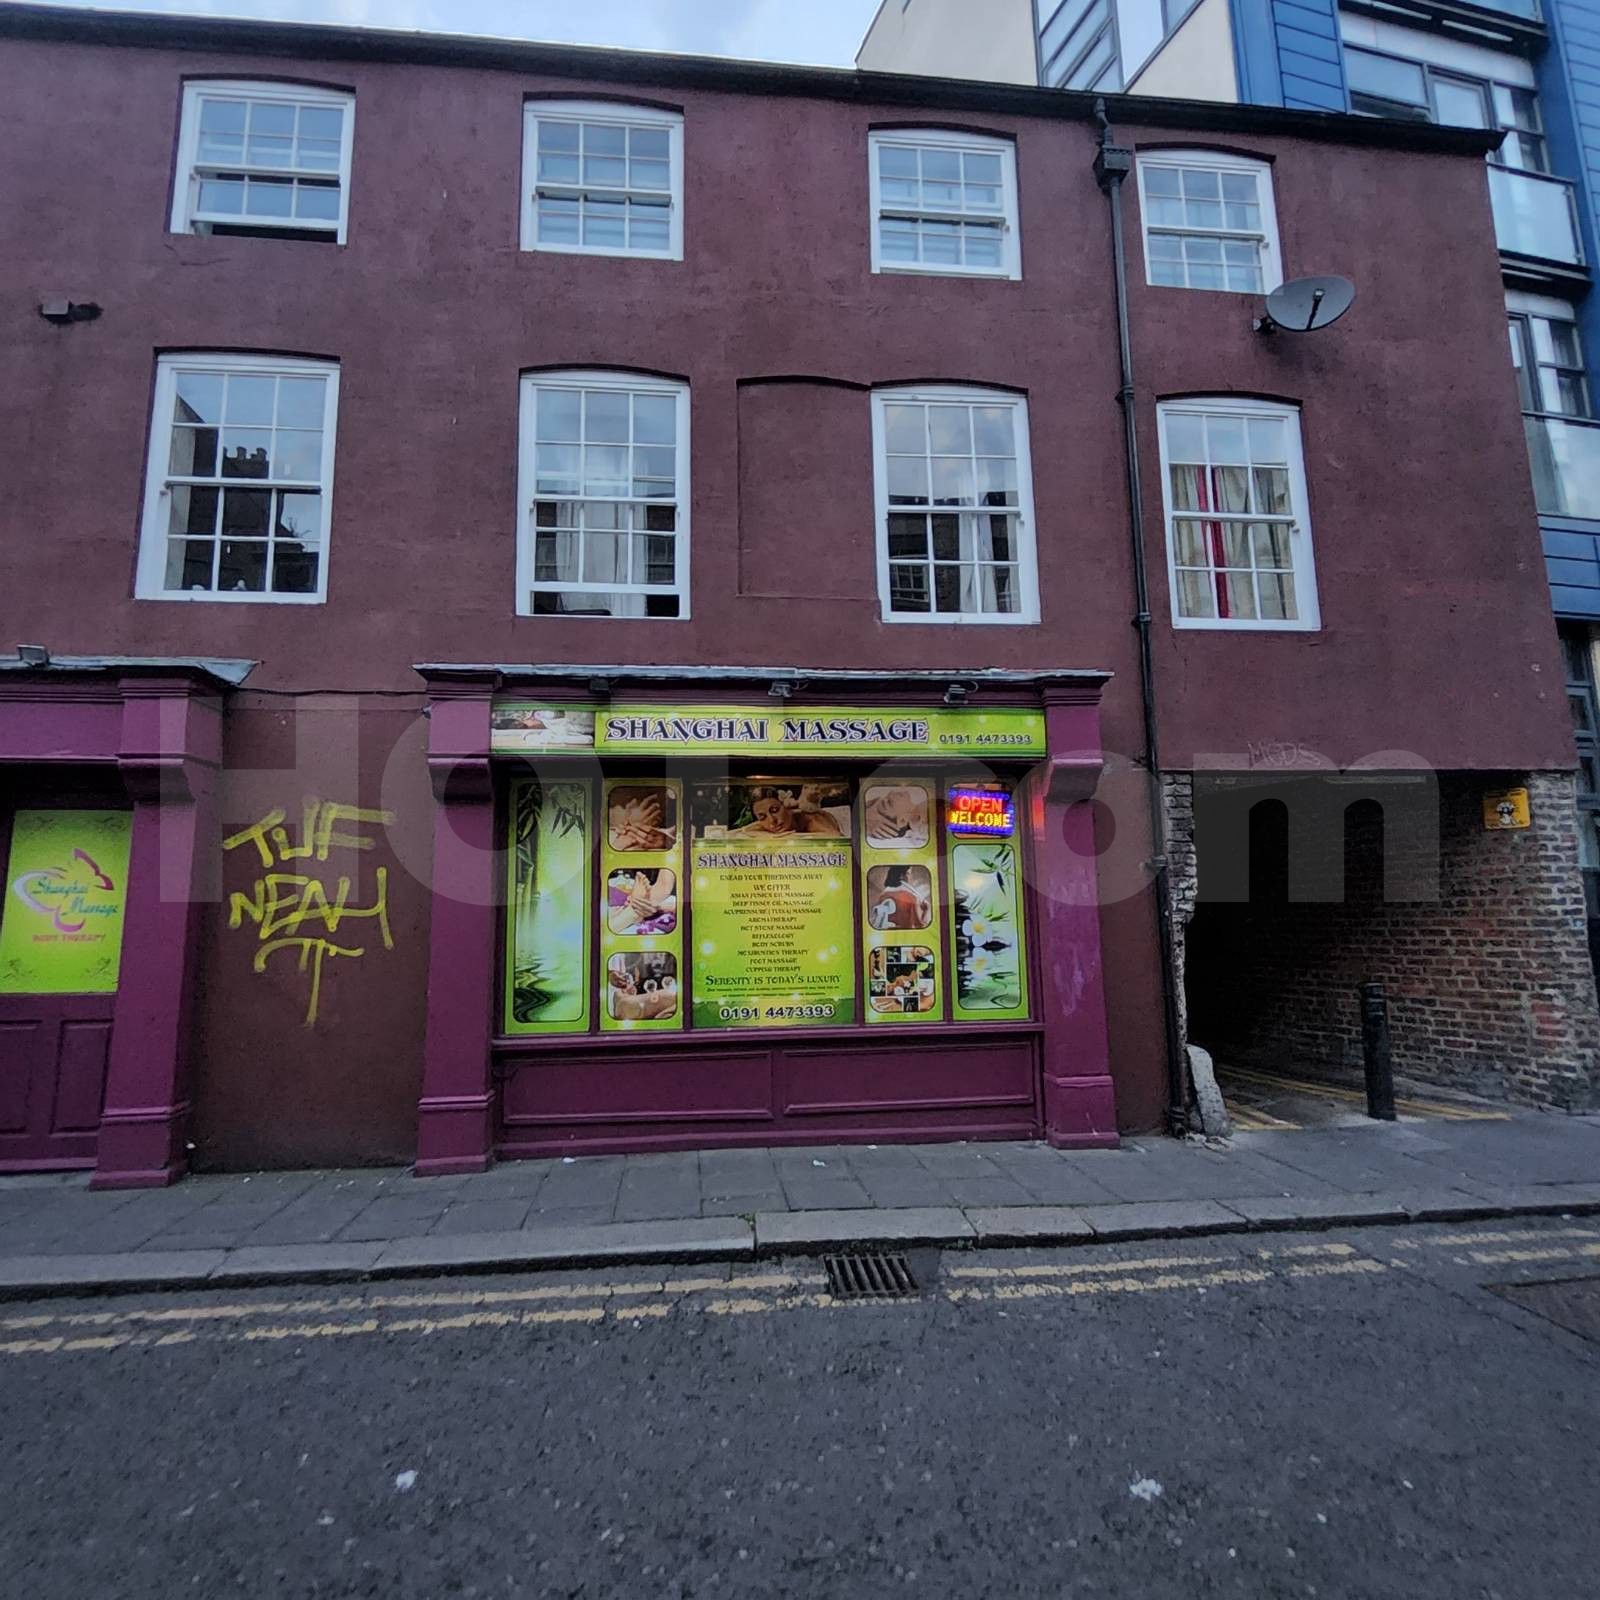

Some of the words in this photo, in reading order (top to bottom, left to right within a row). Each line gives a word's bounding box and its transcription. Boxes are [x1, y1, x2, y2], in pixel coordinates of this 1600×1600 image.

[605, 717, 768, 744] SHANGHAI
[779, 718, 929, 743] MASSAGE
[939, 734, 971, 744] 0191
[976, 734, 1033, 744] 4473393
[959, 795, 1004, 812] OPEN
[949, 810, 1013, 827] WELCOME
[698, 853, 774, 868] SHANGHAI
[777, 853, 848, 867] MASSAGE
[806, 975, 841, 984] LUXURY
[720, 1007, 760, 1020] 0191
[765, 1006, 834, 1018] 4473393
